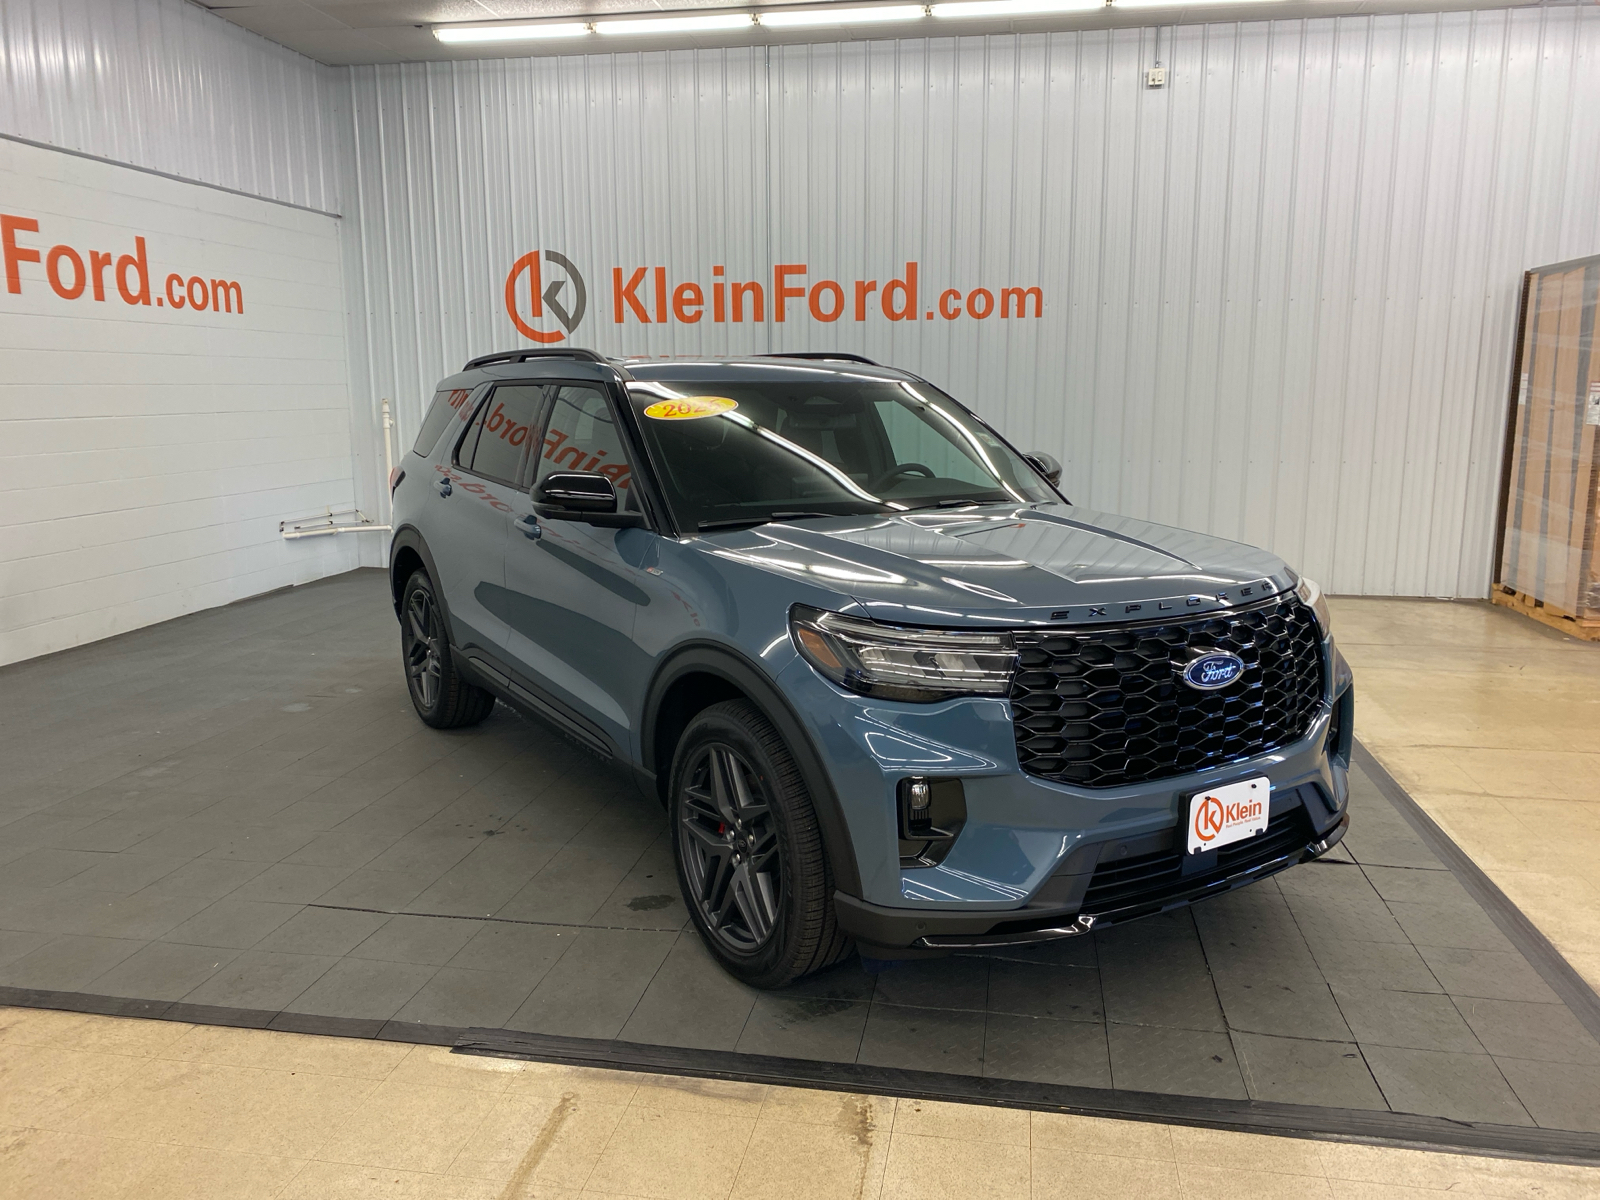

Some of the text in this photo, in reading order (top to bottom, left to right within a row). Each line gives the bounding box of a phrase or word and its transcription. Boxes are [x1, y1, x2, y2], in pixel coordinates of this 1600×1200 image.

[0, 213, 244, 314] Ford.com
[612, 261, 1043, 324] KleinFord.com
[1050, 580, 1274, 620] EXPLORER
[1201, 660, 1236, 682] Ford
[1225, 799, 1262, 824] Klein
